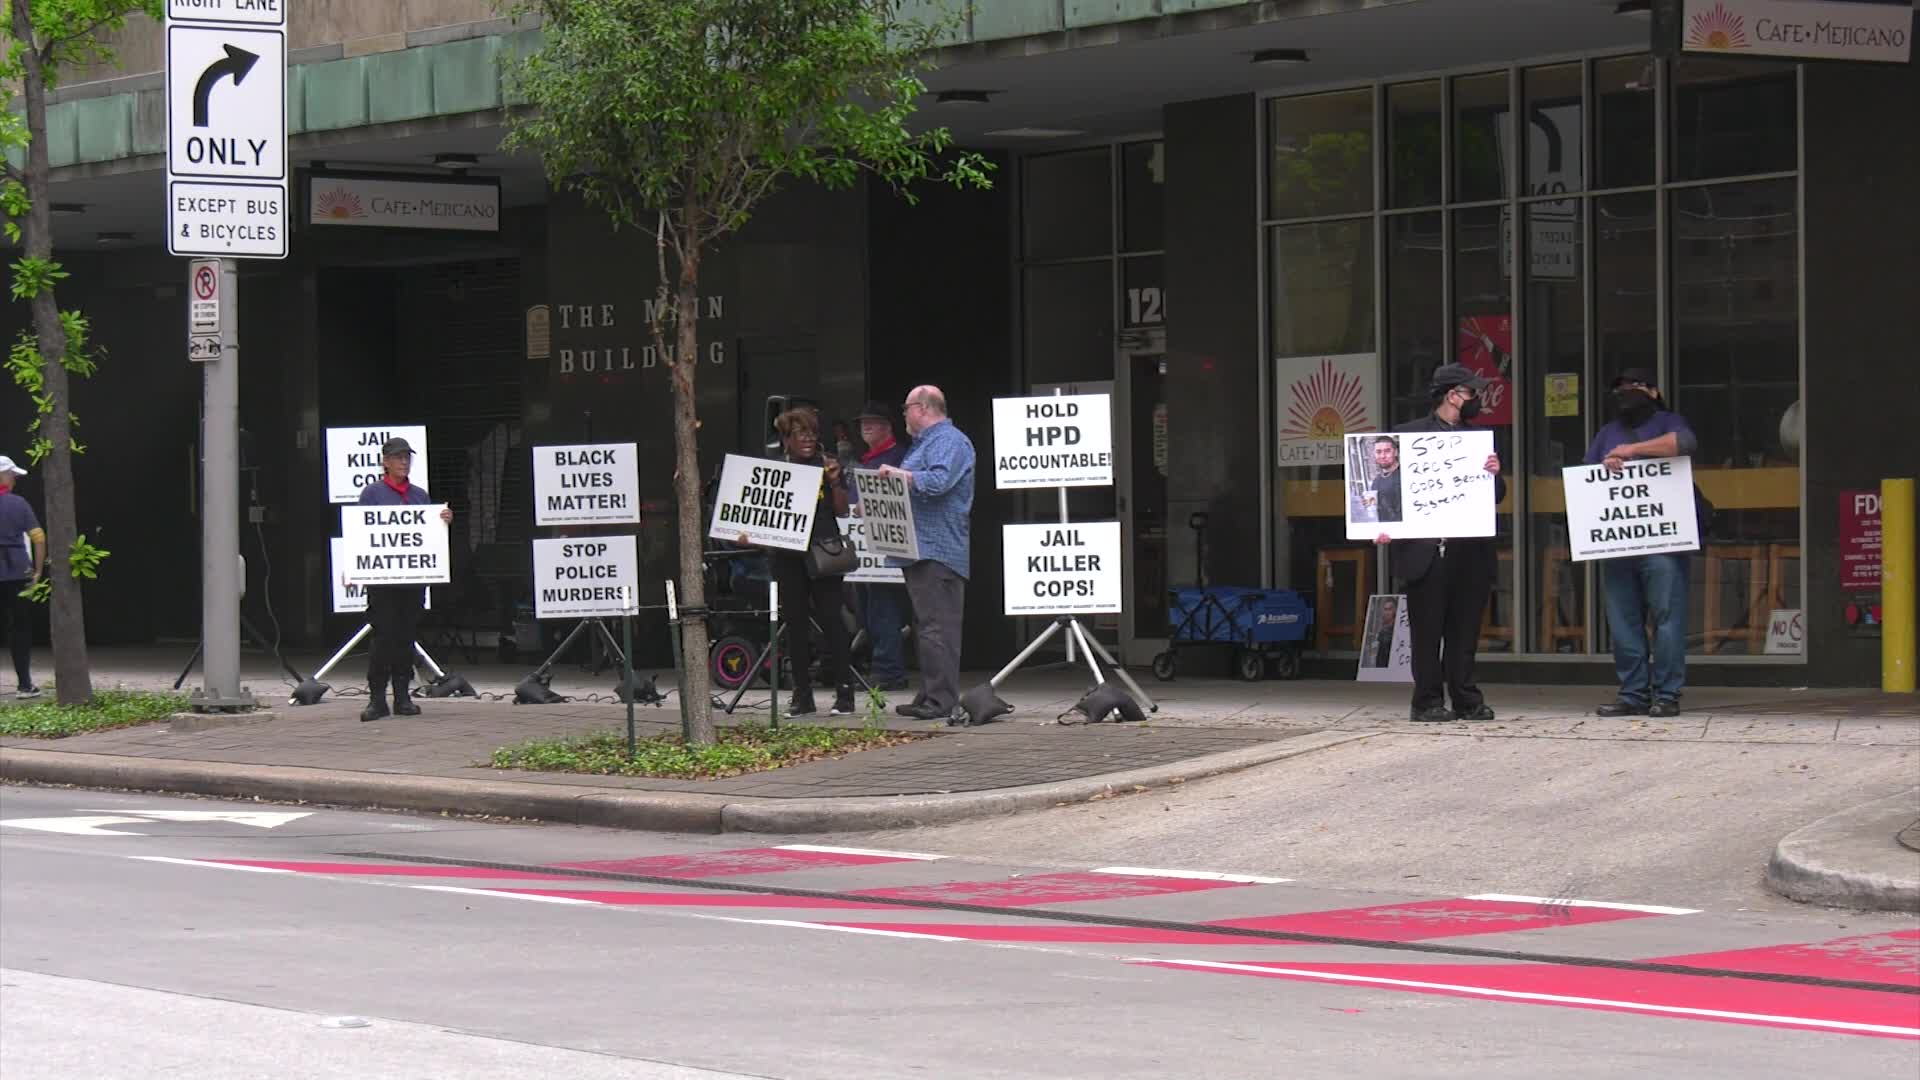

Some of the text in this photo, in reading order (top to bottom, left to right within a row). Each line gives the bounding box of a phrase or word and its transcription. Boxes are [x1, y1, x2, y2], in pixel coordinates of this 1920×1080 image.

[1814, 20, 1905, 48] MEJICANO
[187, 136, 267, 166] ONLY
[177, 197, 278, 215] EXCEPT BUS
[181, 223, 276, 241] & BICYCLES
[559, 304, 614, 328] THE
[1026, 403, 1079, 418] HOLD
[1026, 425, 1081, 447] HPD
[1411, 435, 1463, 457] STOP
[347, 453, 384, 468] KILL
[555, 450, 616, 466] BLACK
[999, 452, 1112, 471] ACCOUNTABLE!
[561, 472, 613, 488] LIVES
[751, 466, 791, 489] STOP
[1585, 462, 1672, 483] JUSTICE
[857, 474, 904, 497] DEFEND
[1609, 484, 1650, 500] FOR
[547, 493, 626, 511] MATTER!
[740, 485, 794, 510] POLICE
[364, 510, 426, 526] BLACK
[719, 503, 808, 533] BRUTALITY!
[863, 498, 908, 521] BROWN
[1599, 502, 1664, 521] JALEN
[370, 532, 424, 548] LIVES
[871, 523, 909, 545] LIVES!
[1040, 529, 1085, 547] JAIL
[1590, 521, 1678, 543] RANDLE!
[563, 543, 607, 557] STOP
[357, 553, 437, 570] MATTER!
[1027, 554, 1101, 573] KILLER
[555, 565, 618, 580] POLICE
[1033, 580, 1094, 597] COPS!
